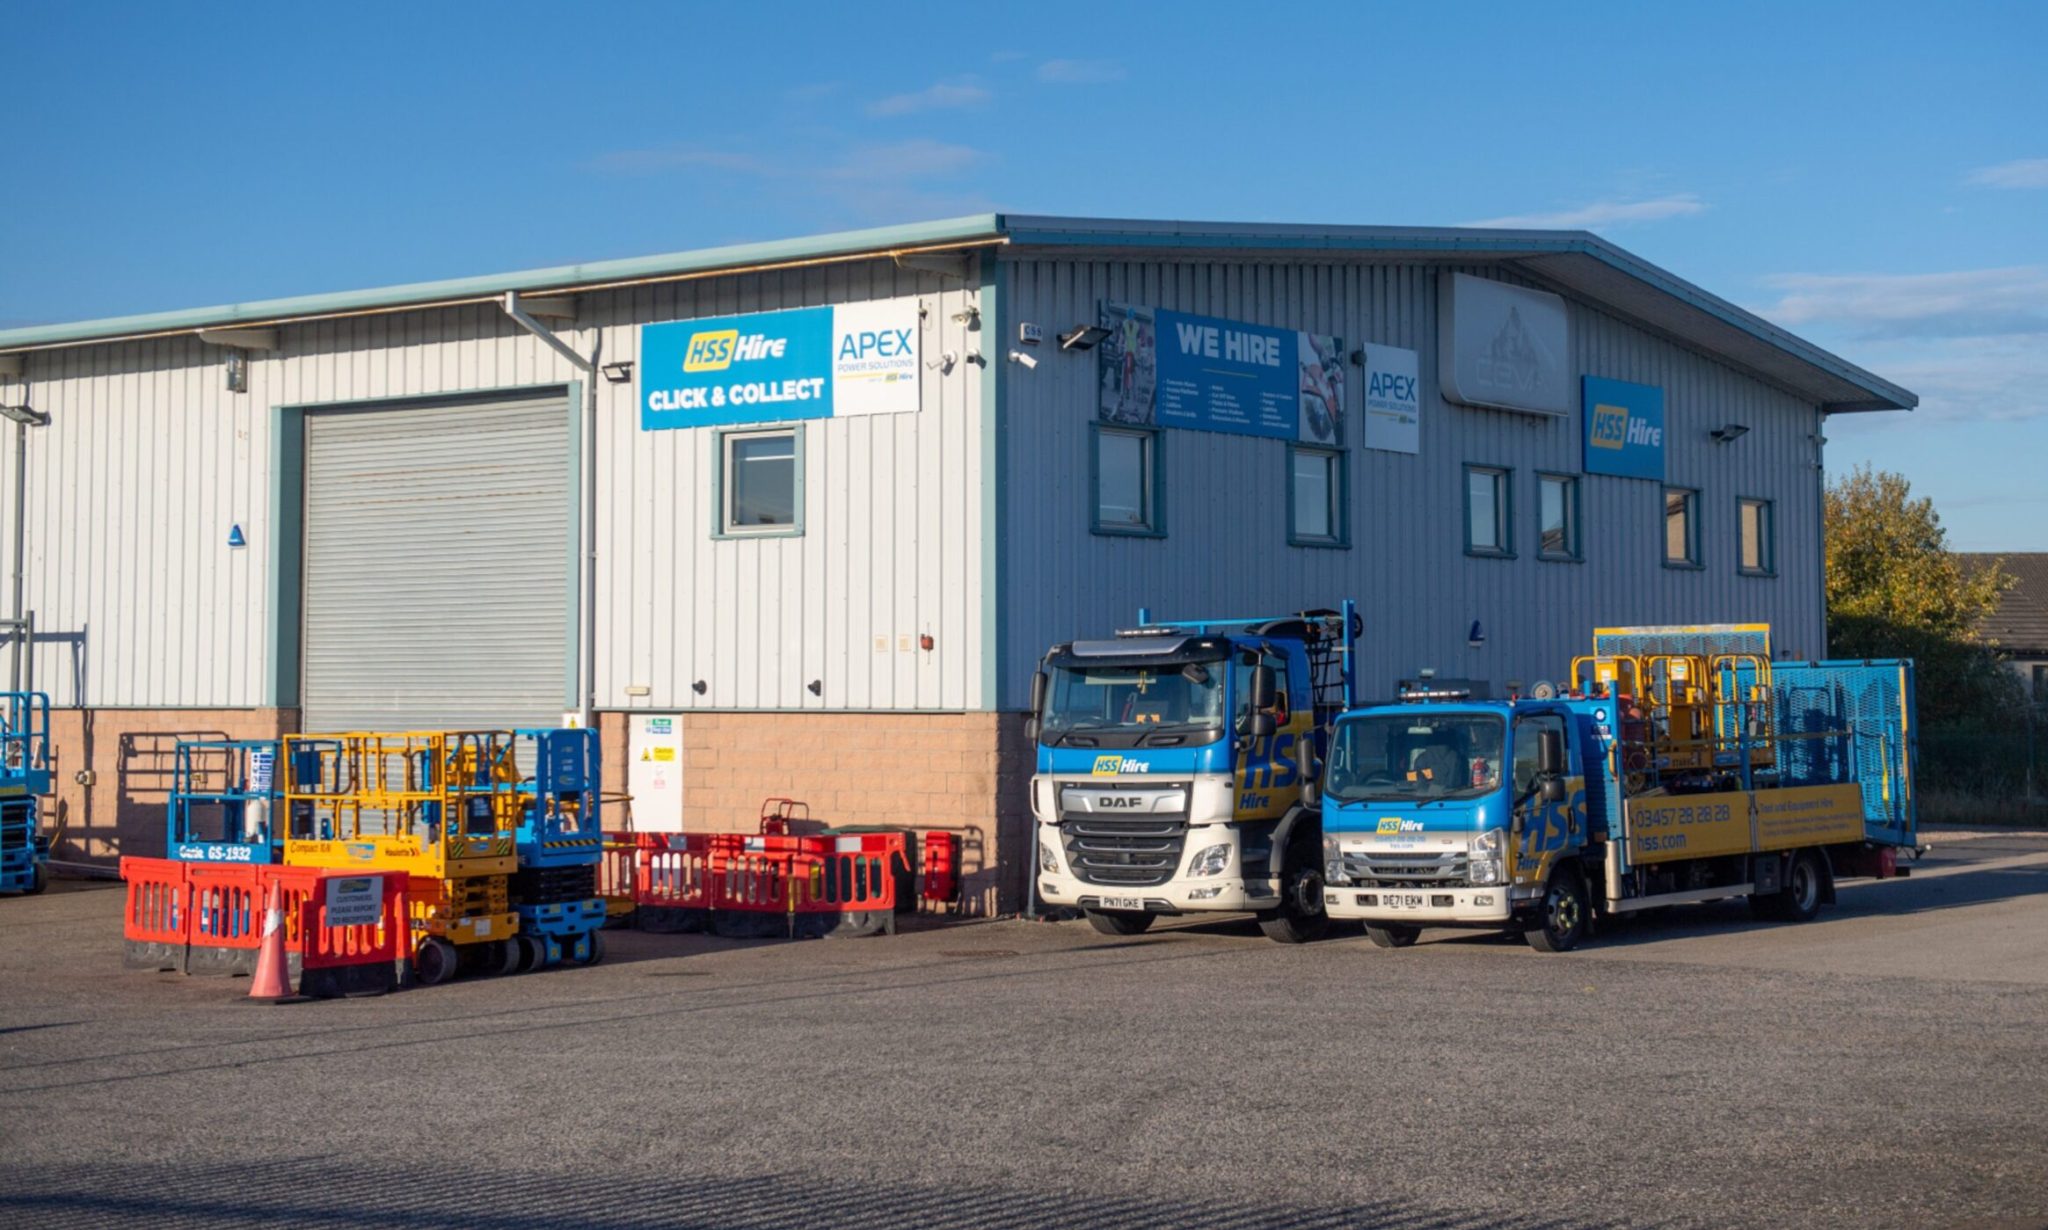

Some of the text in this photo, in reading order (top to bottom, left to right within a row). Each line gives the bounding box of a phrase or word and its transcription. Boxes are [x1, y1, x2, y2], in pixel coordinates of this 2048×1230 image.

[689, 334, 788, 364] HSS Hire
[838, 328, 913, 361] APEX
[1176, 322, 1280, 367] WE HIRE
[838, 359, 914, 372] POWER SOLUTIONS
[648, 378, 825, 411] CLICK & COLLECT
[1368, 371, 1416, 403] APEX
[1594, 413, 1662, 447] HSS Hire
[1097, 759, 1150, 773] HSS Hire
[1243, 732, 1322, 789] HS
[1099, 797, 1142, 807] DAF
[1239, 793, 1270, 810] Hire
[1635, 804, 1730, 828] 03457 28 28 28
[1400, 820, 1424, 831] Hire
[1637, 833, 1687, 851] hss.com
[208, 846, 251, 861] GS-1932
[353, 904, 376, 912] REPORT
[1383, 895, 1403, 905] DE71
